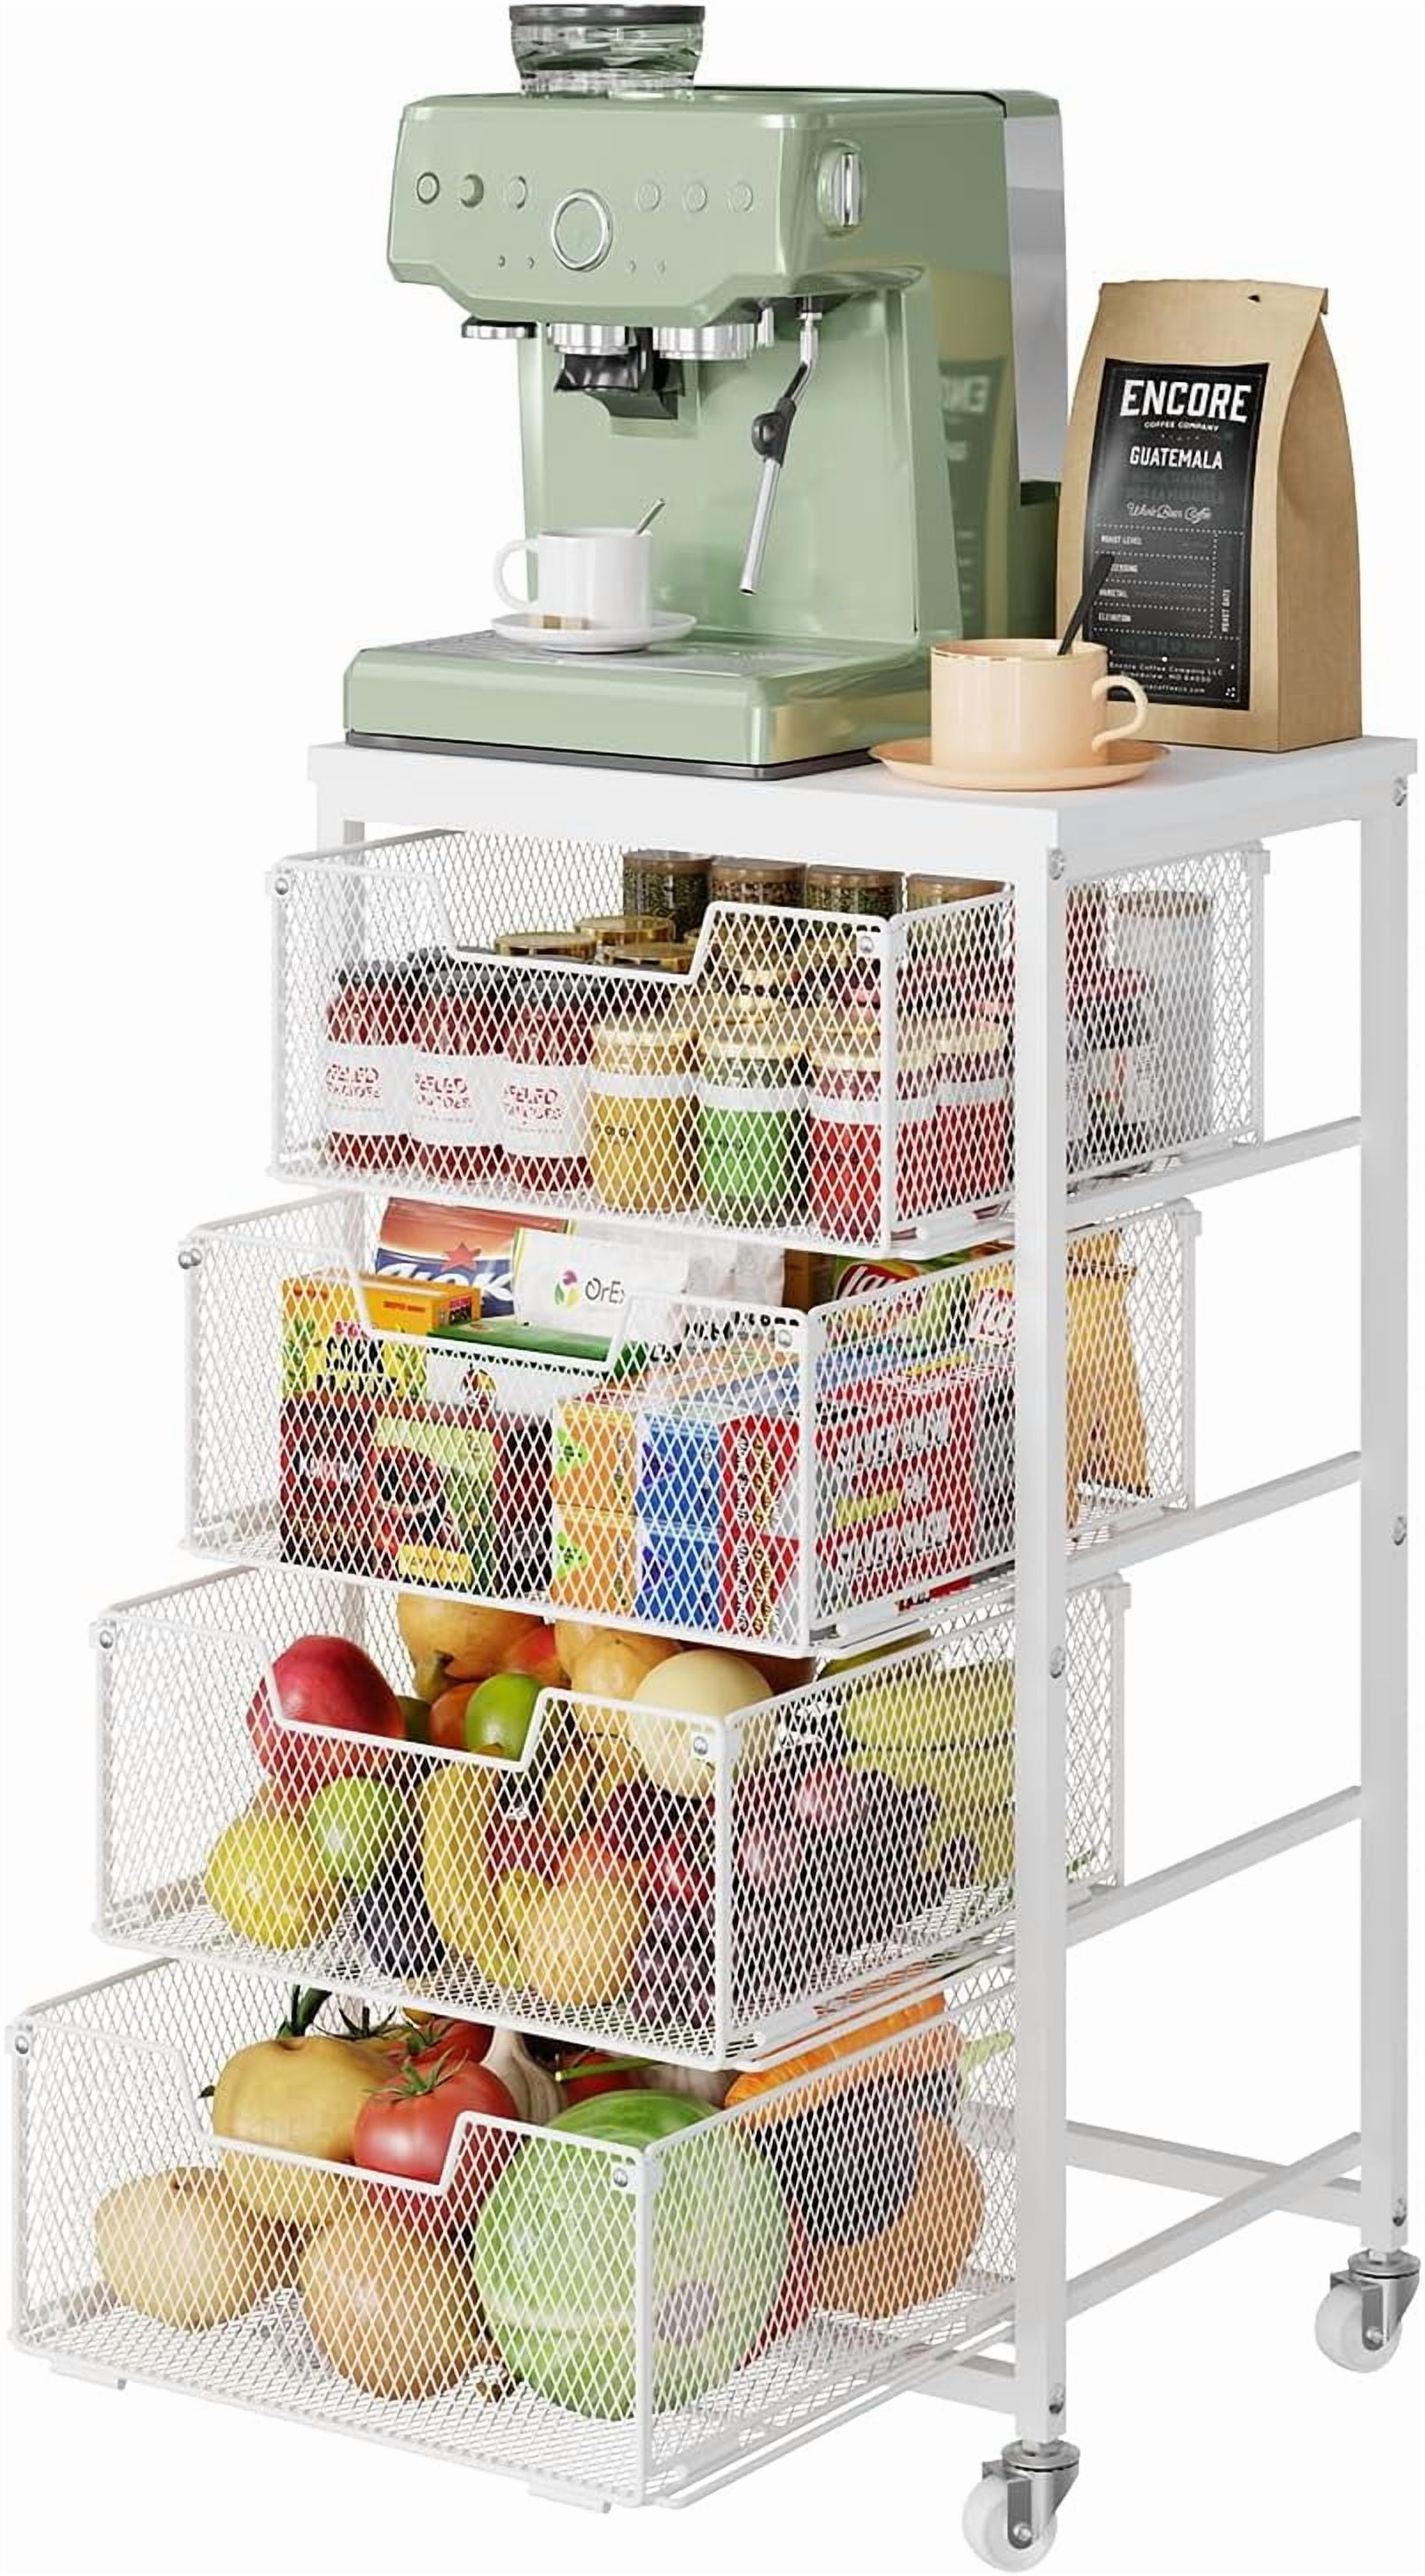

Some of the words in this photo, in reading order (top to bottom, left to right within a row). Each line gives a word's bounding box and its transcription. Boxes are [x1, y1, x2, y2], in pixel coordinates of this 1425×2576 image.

[1120, 379, 1251, 423] ENCORE
[1178, 421, 1219, 432] COMPANY
[1130, 446, 1222, 469] GUATEMALA
